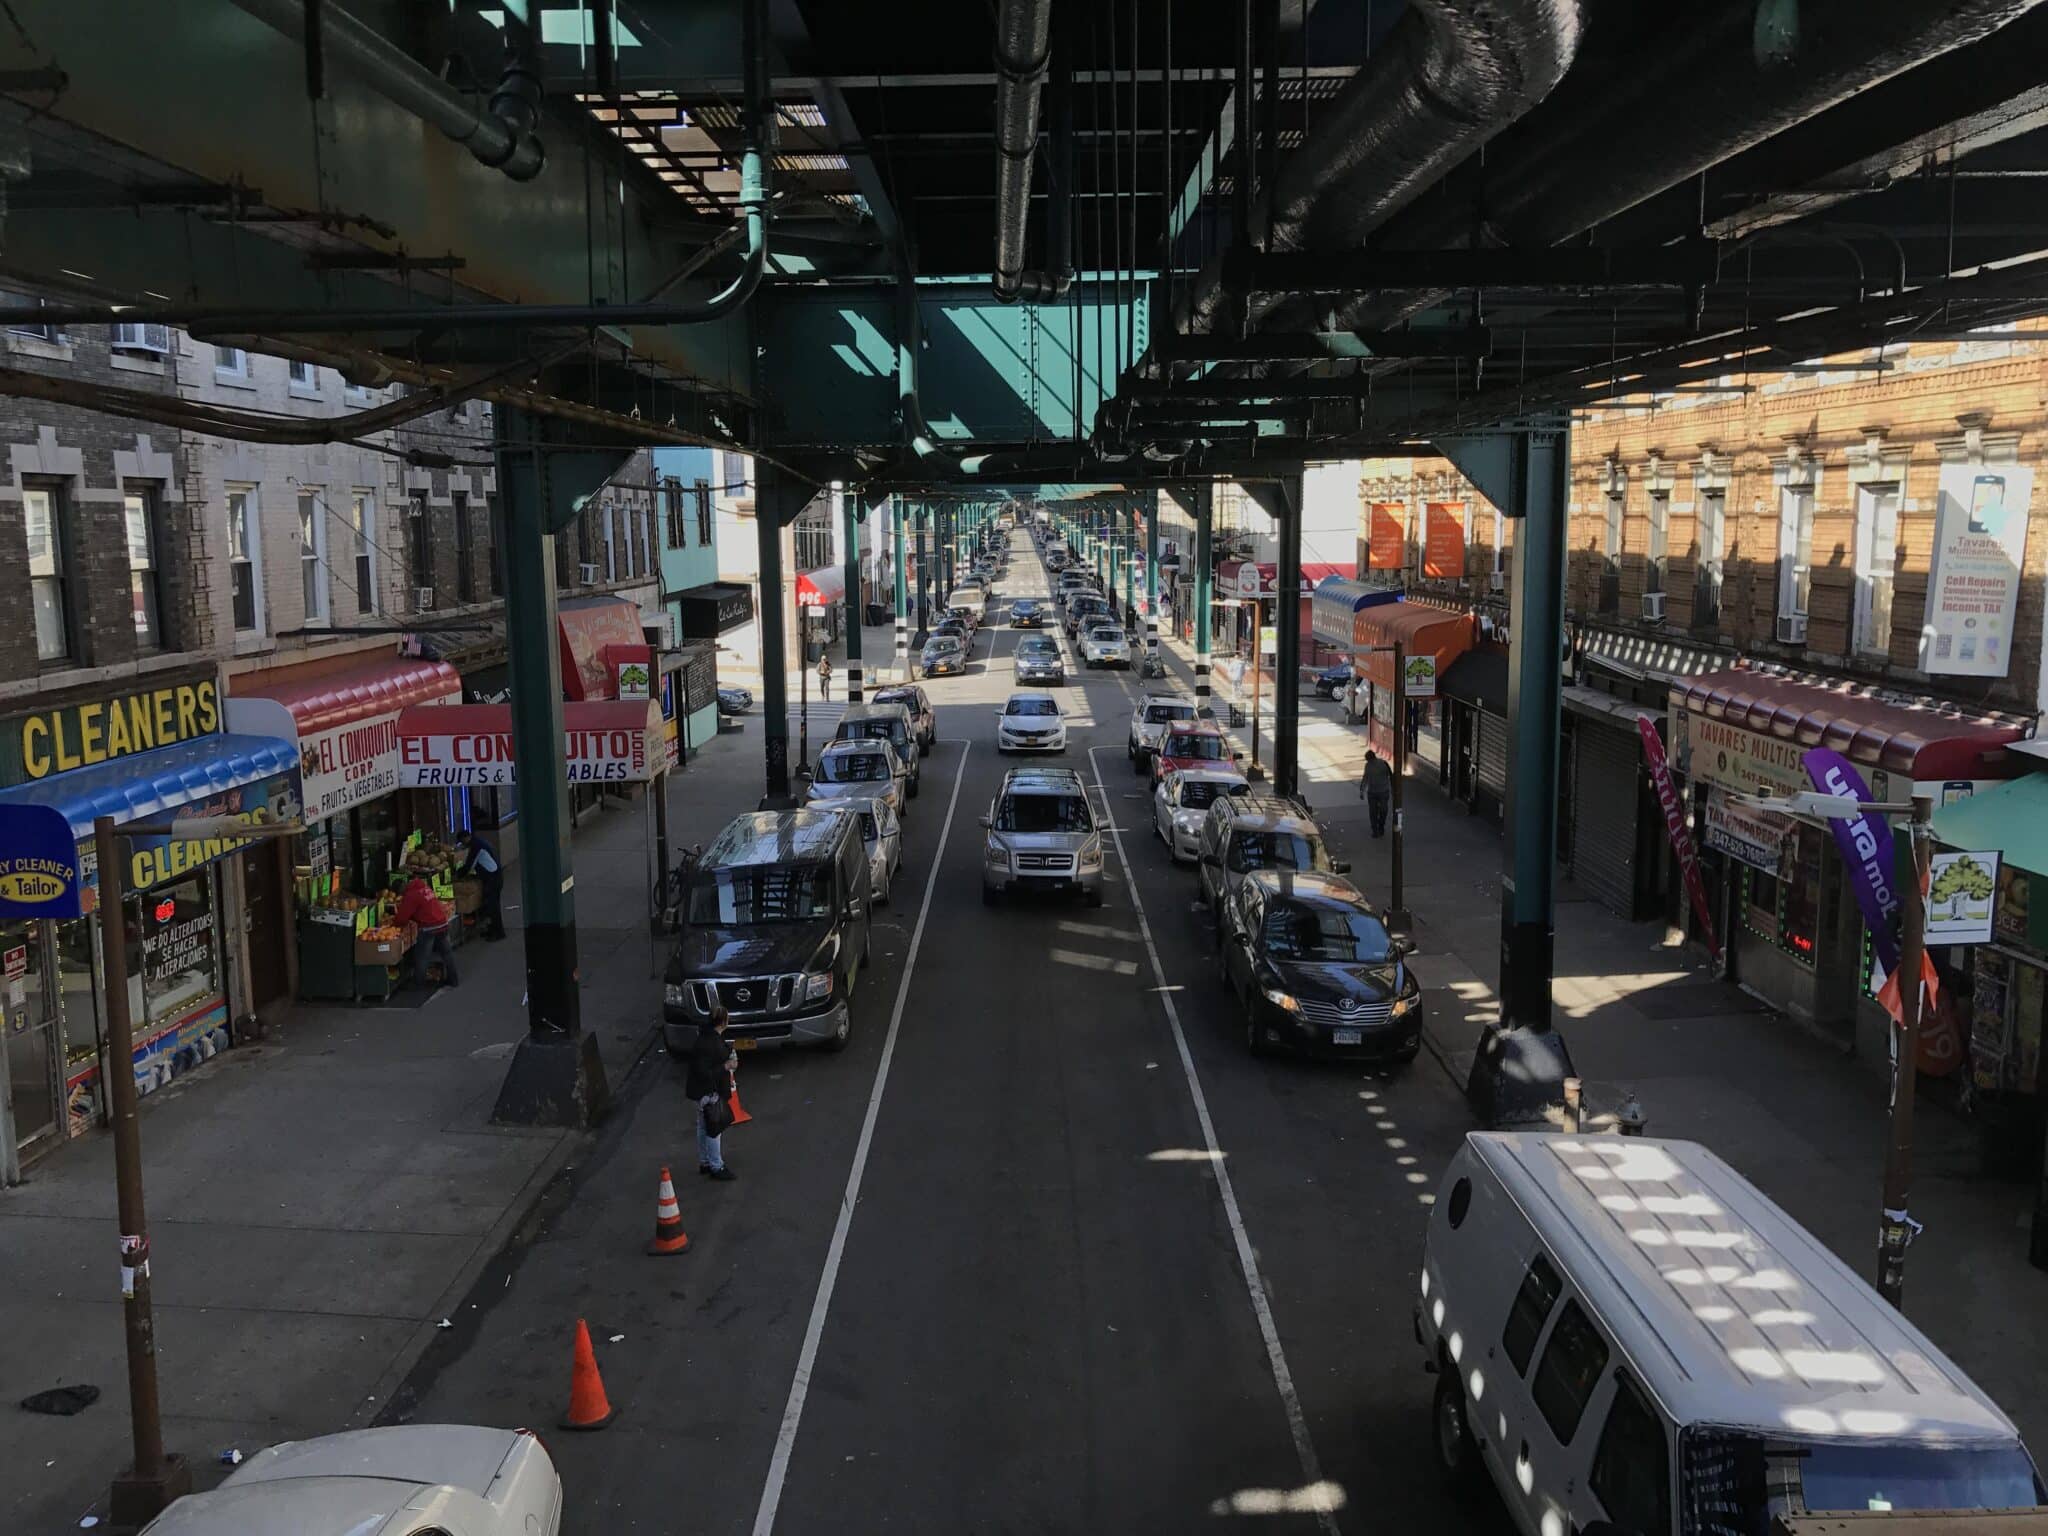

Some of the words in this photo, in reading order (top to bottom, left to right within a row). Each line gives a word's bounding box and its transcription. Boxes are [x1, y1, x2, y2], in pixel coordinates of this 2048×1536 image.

[1945, 575, 1966, 586] Cell
[1967, 576, 2007, 588] Repairs
[1942, 601, 1981, 613] Income
[23, 681, 217, 778] CLEANERS
[319, 738, 337, 775] EL
[338, 719, 398, 768] CONUQUITO
[401, 736, 441, 765] EL
[452, 731, 630, 764] CONUITO
[1700, 721, 1747, 753] TAVARES
[1751, 738, 1806, 774] MULTISE
[321, 786, 348, 812] FRUITS
[353, 769, 394, 799] VEGETABLES
[417, 767, 488, 785] FRUITS
[493, 768, 505, 783] &
[0, 884, 10, 896] &
[15, 877, 58, 897] Tailor
[15, 858, 74, 882] CLEANER
[143, 936, 157, 954] WE
[158, 931, 169, 949] DO
[169, 913, 213, 943] ALTERATIONS
[162, 945, 172, 962] SE
[173, 934, 198, 957] HACEN
[155, 945, 208, 981] ALTERACIONES
